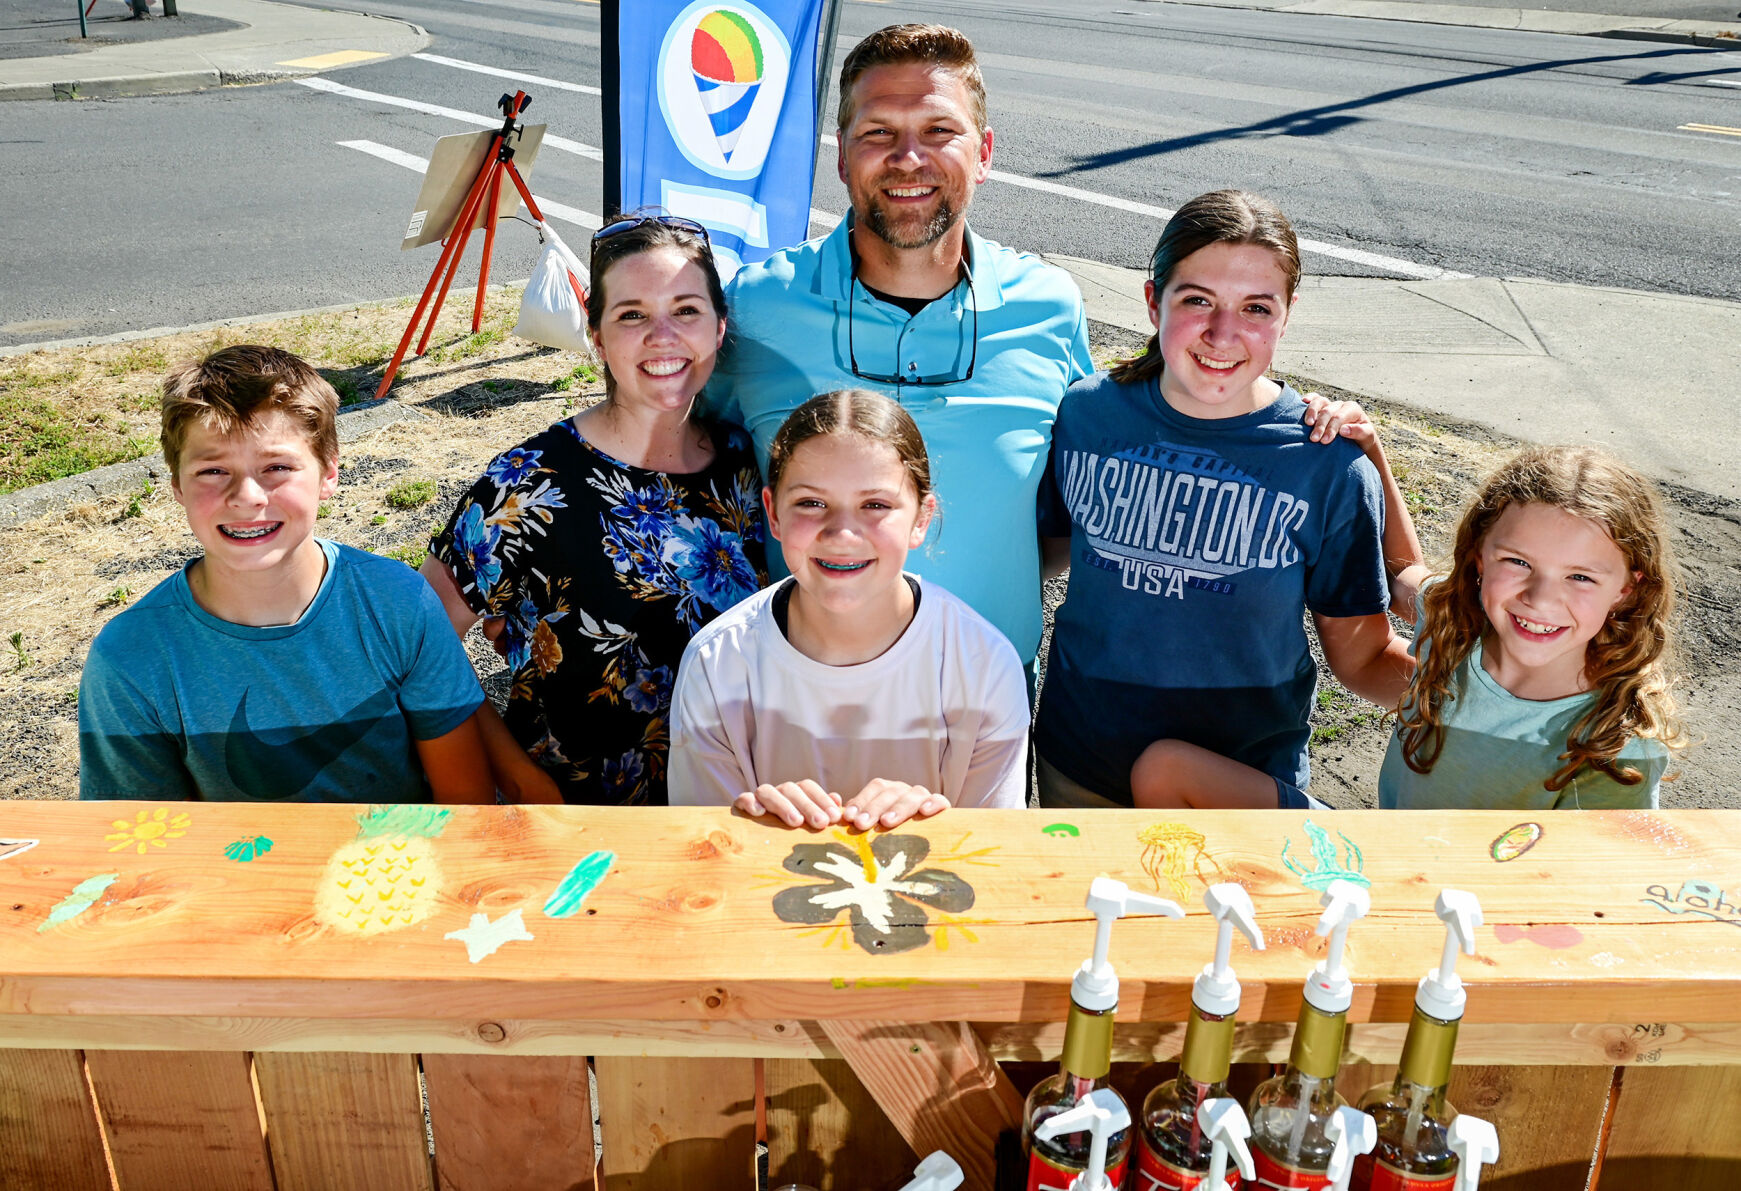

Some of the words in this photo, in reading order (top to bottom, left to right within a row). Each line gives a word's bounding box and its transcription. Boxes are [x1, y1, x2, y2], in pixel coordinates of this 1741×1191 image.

[1100, 437, 1179, 464] NATION'S
[1191, 456, 1275, 481] CAPITAL
[1063, 450, 1266, 566] WASHINGTON
[1258, 491, 1310, 569] DC
[1085, 553, 1112, 571] EST.
[1122, 559, 1184, 600] USA
[1194, 579, 1232, 594] 1790
[1646, 882, 1741, 915] aloh
